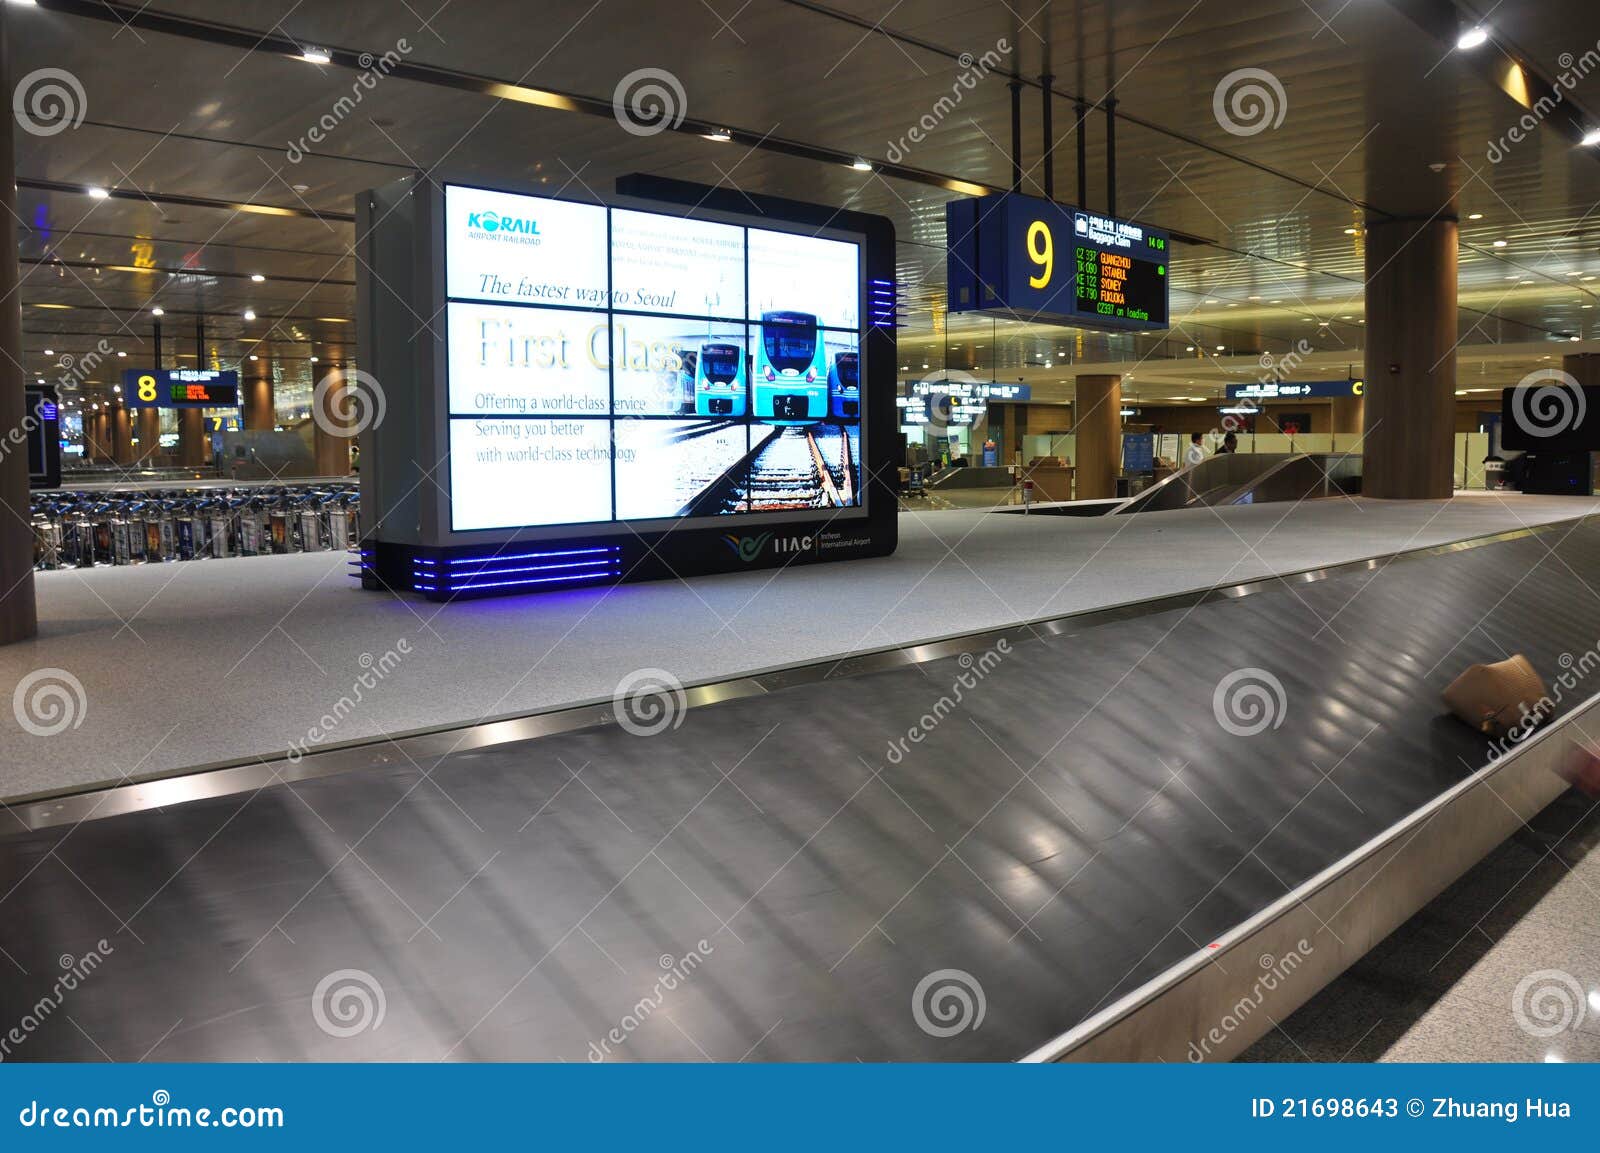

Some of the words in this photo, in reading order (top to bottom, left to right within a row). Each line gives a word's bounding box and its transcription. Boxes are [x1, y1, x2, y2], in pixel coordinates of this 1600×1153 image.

[468, 211, 541, 235] KORAIL
[468, 232, 501, 243] AIRPORT
[503, 235, 541, 246] RAILROAD
[1089, 229, 1114, 246] Baggage
[1115, 234, 1131, 248] Claim
[1027, 220, 1054, 289] 9
[1100, 252, 1131, 269] GUANGZHOU
[1101, 265, 1127, 280] ISTANBUL
[480, 273, 511, 294] The
[517, 276, 570, 300] fastest
[576, 287, 611, 307] way
[613, 290, 629, 304] to
[633, 287, 677, 308] Seoul
[1101, 278, 1122, 291] SYDNEY
[1101, 290, 1125, 304] FUKUOKA
[1126, 307, 1148, 321] loading
[478, 317, 570, 369] First
[586, 323, 684, 371] Class
[138, 375, 157, 401] 8
[1352, 381, 1363, 395] C
[475, 392, 526, 412] Offering
[530, 398, 538, 410] a
[543, 394, 605, 410] world-class
[213, 417, 222, 431] 7
[475, 421, 520, 439] Serving
[524, 426, 547, 439] you
[551, 421, 584, 436] better
[476, 447, 502, 462] with
[507, 446, 573, 462] world-class
[775, 536, 812, 553] IIAC
[821, 540, 853, 549] International
[853, 537, 871, 546] Airport
